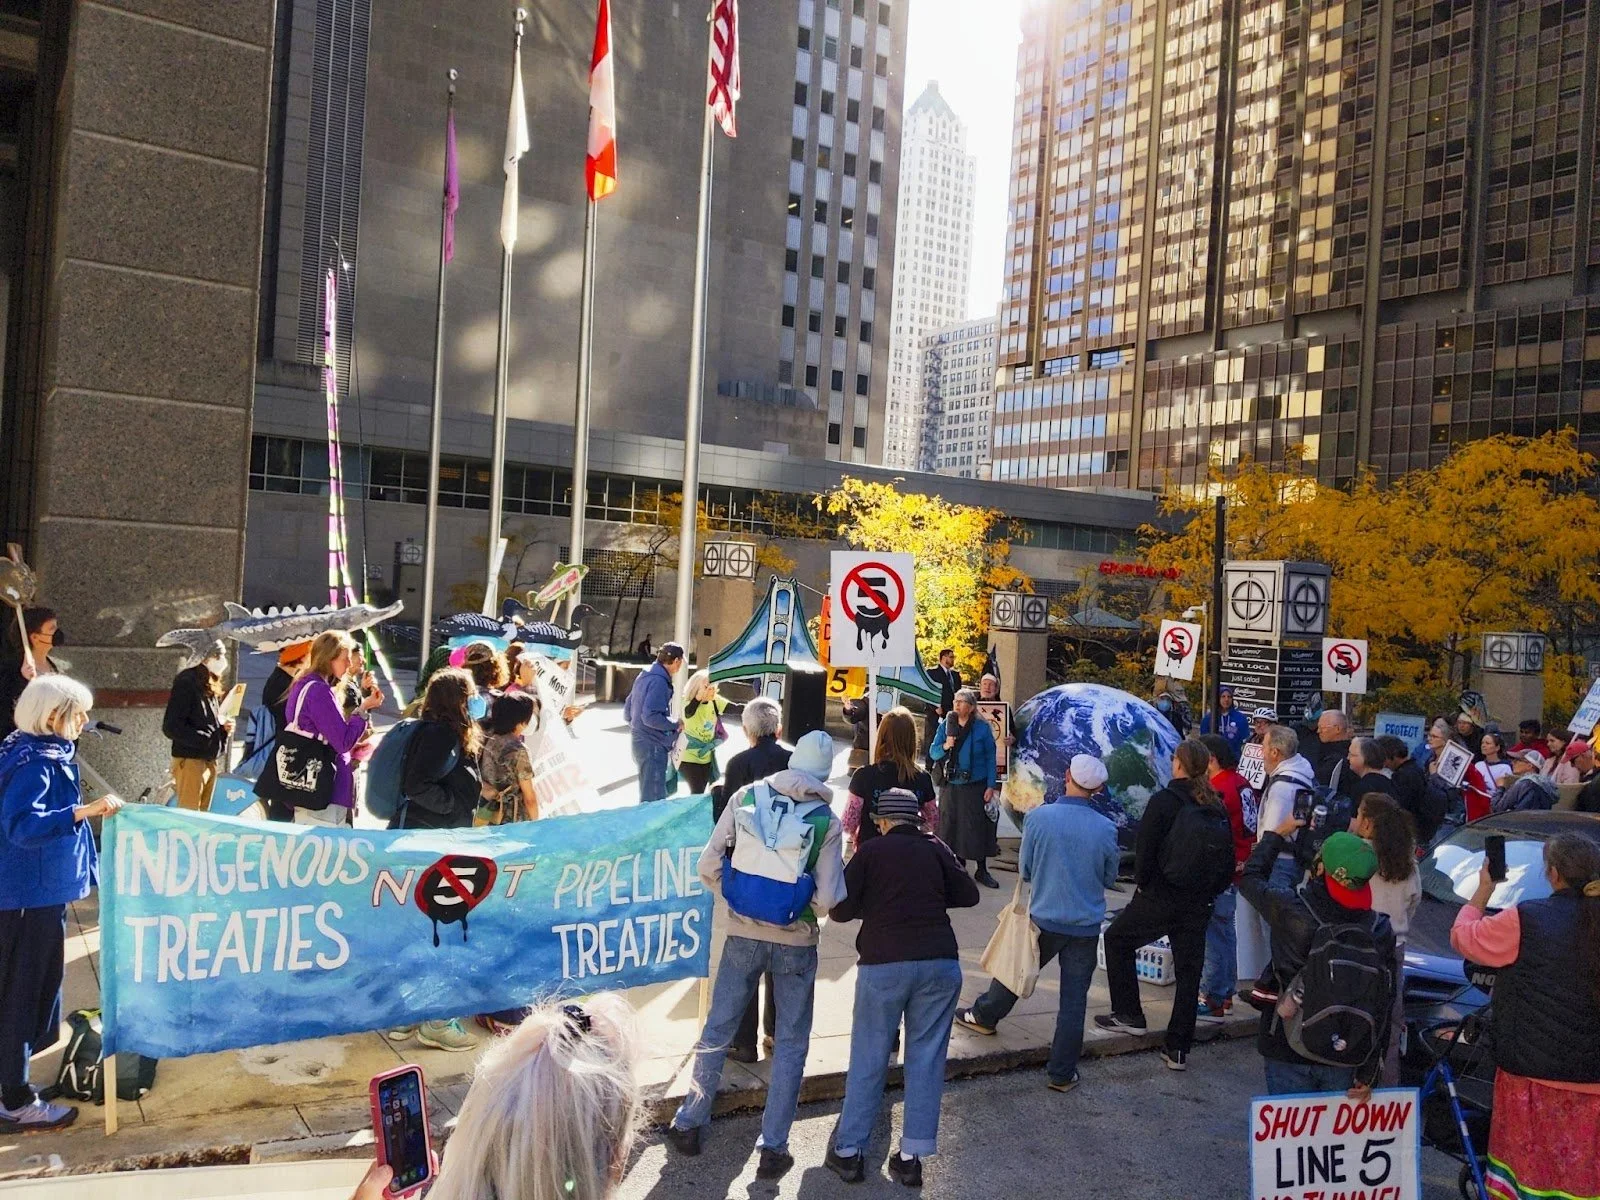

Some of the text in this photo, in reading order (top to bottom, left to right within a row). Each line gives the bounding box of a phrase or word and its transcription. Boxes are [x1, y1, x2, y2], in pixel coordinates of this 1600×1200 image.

[1222, 661, 1271, 671] ESTA LOCA
[830, 669, 849, 694] 5
[1244, 675, 1260, 683] salad
[1240, 701, 1257, 709] PANDA
[1384, 723, 1419, 739] PROTECT
[1245, 747, 1263, 758] STO
[1240, 758, 1263, 772] LINE
[1239, 769, 1262, 783] IVE
[115, 829, 375, 898] INDIGENOUS
[553, 846, 703, 909] PIPELINE
[124, 901, 350, 984] TREATIES
[552, 909, 701, 979] TREATIES
[1255, 1101, 1412, 1142] SHUT DOWN
[1275, 1137, 1396, 1189] LINE 5
